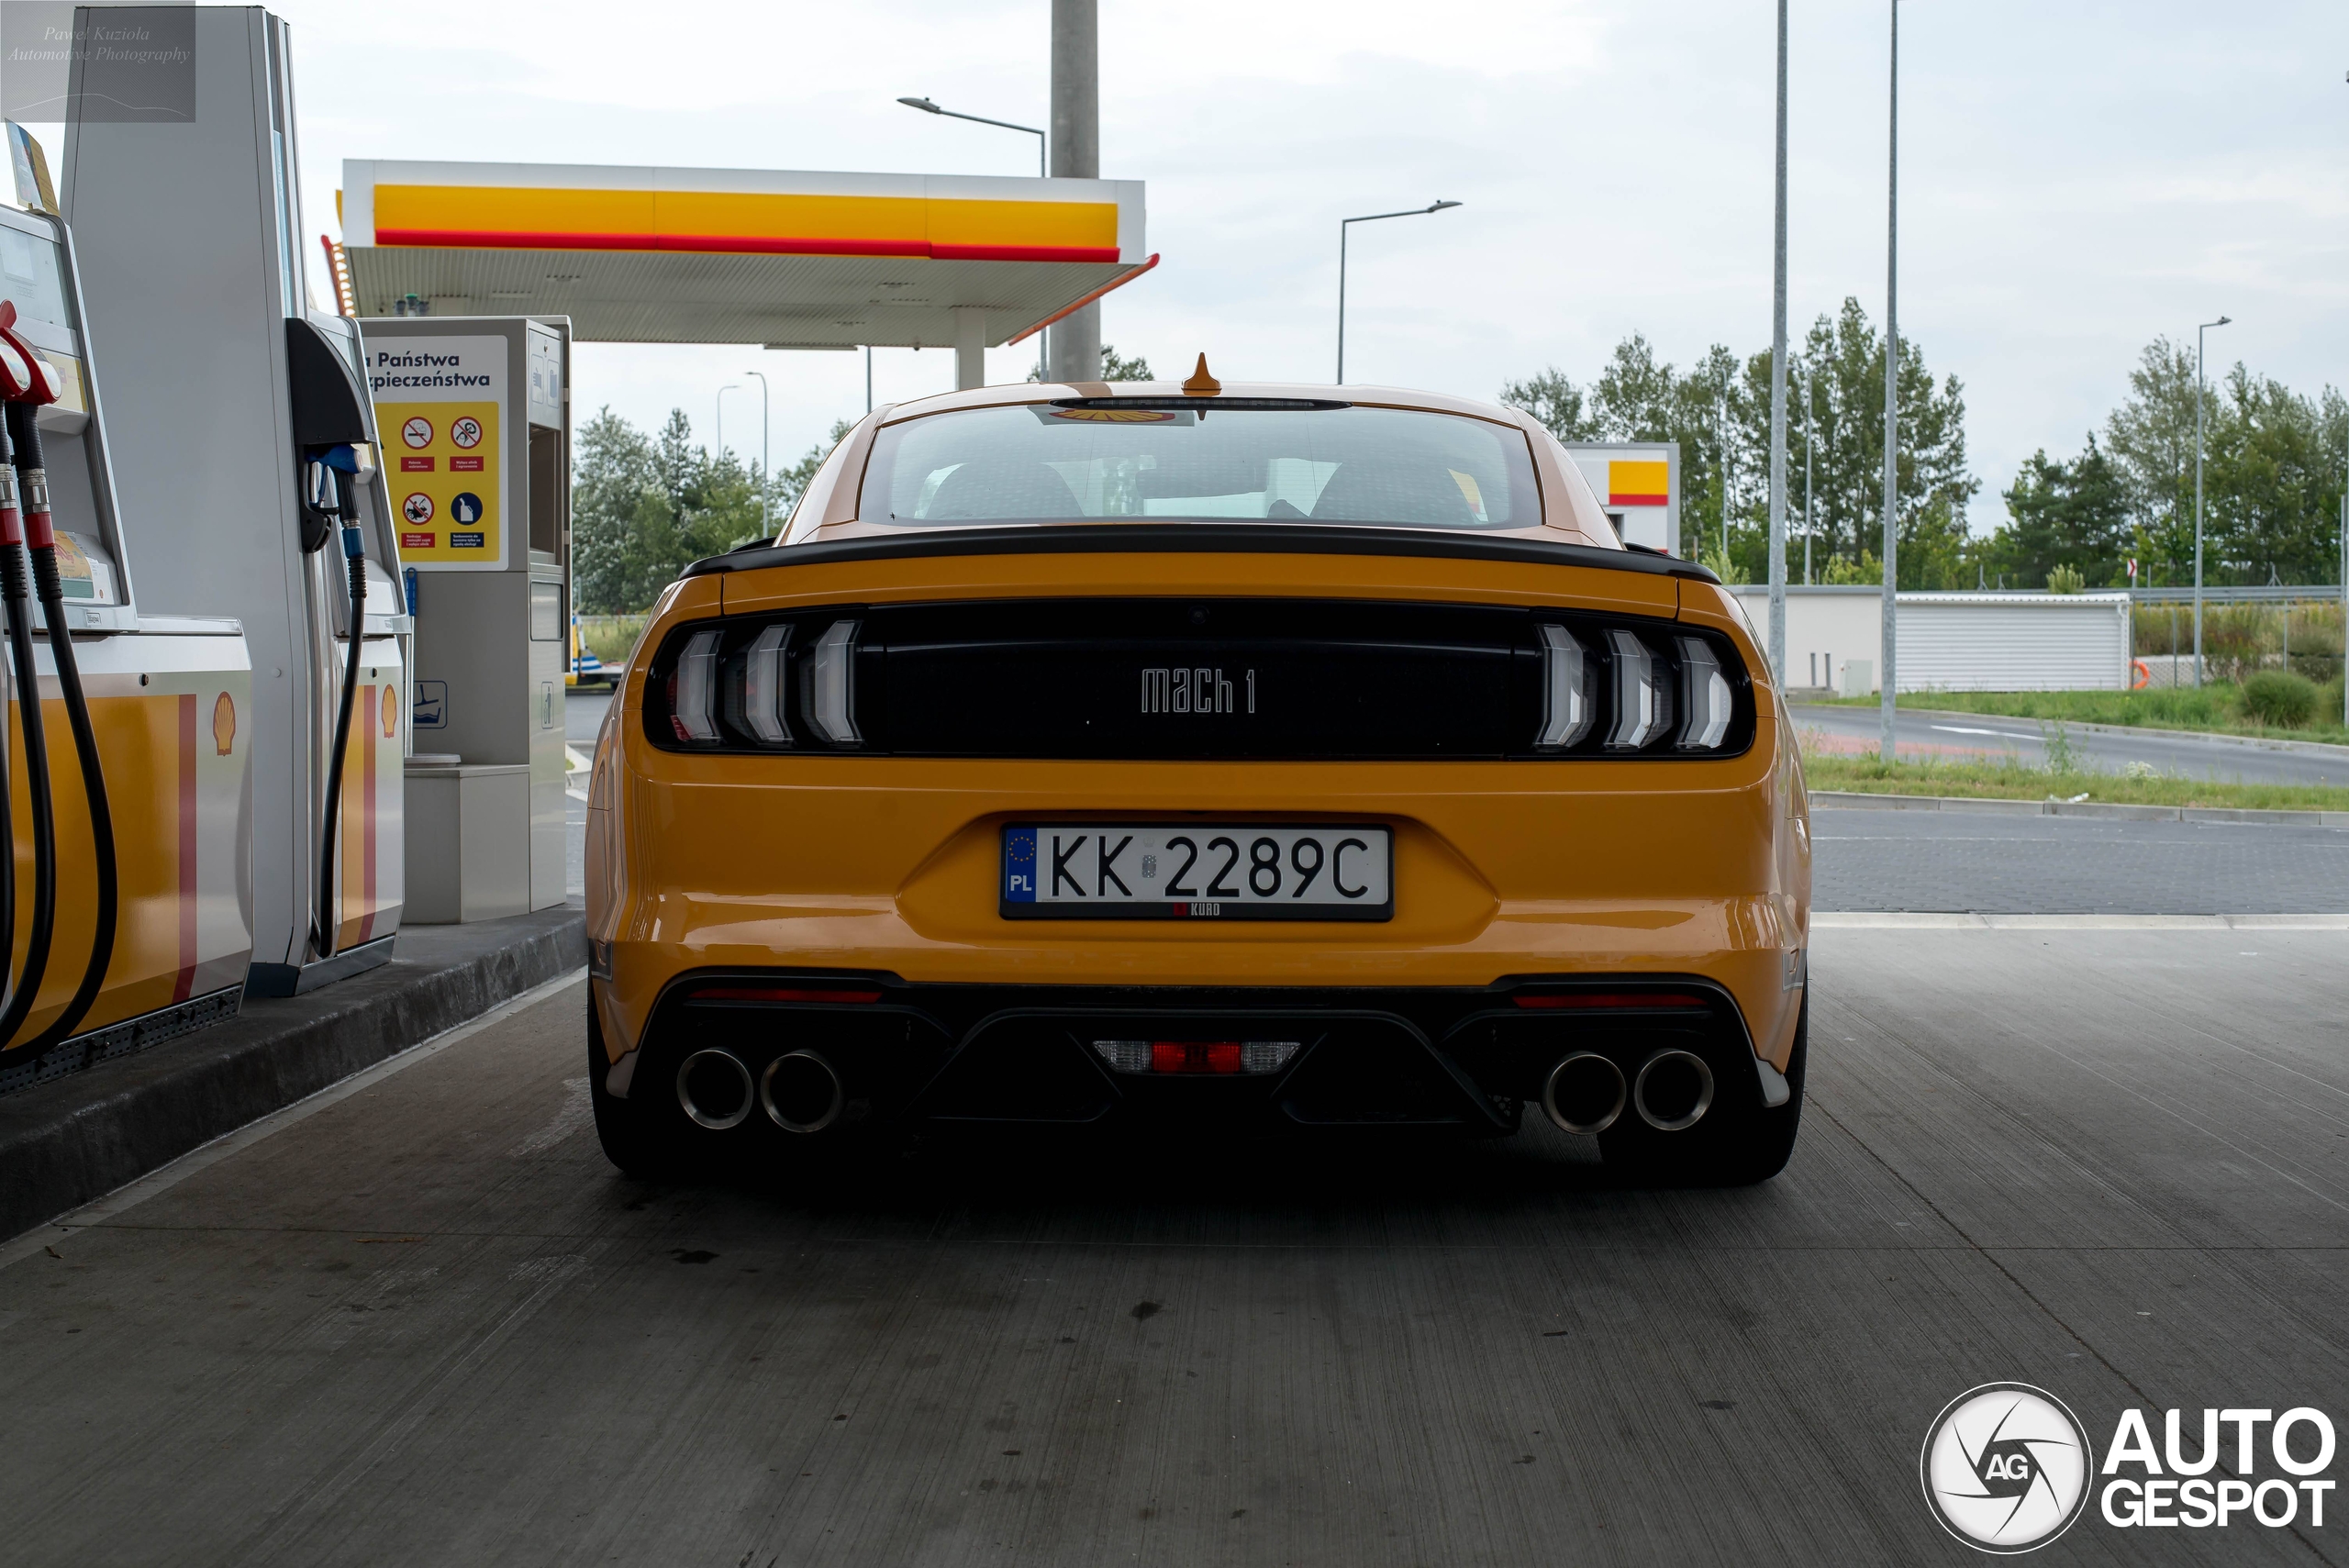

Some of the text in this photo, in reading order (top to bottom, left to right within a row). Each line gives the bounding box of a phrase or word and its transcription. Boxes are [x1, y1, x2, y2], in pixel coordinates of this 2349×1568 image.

[378, 350, 460, 367] Państwa
[1246, 669, 1255, 714] 1
[1009, 835, 1369, 898] PL KK 2289C
[1190, 903, 1220, 917] KURO
